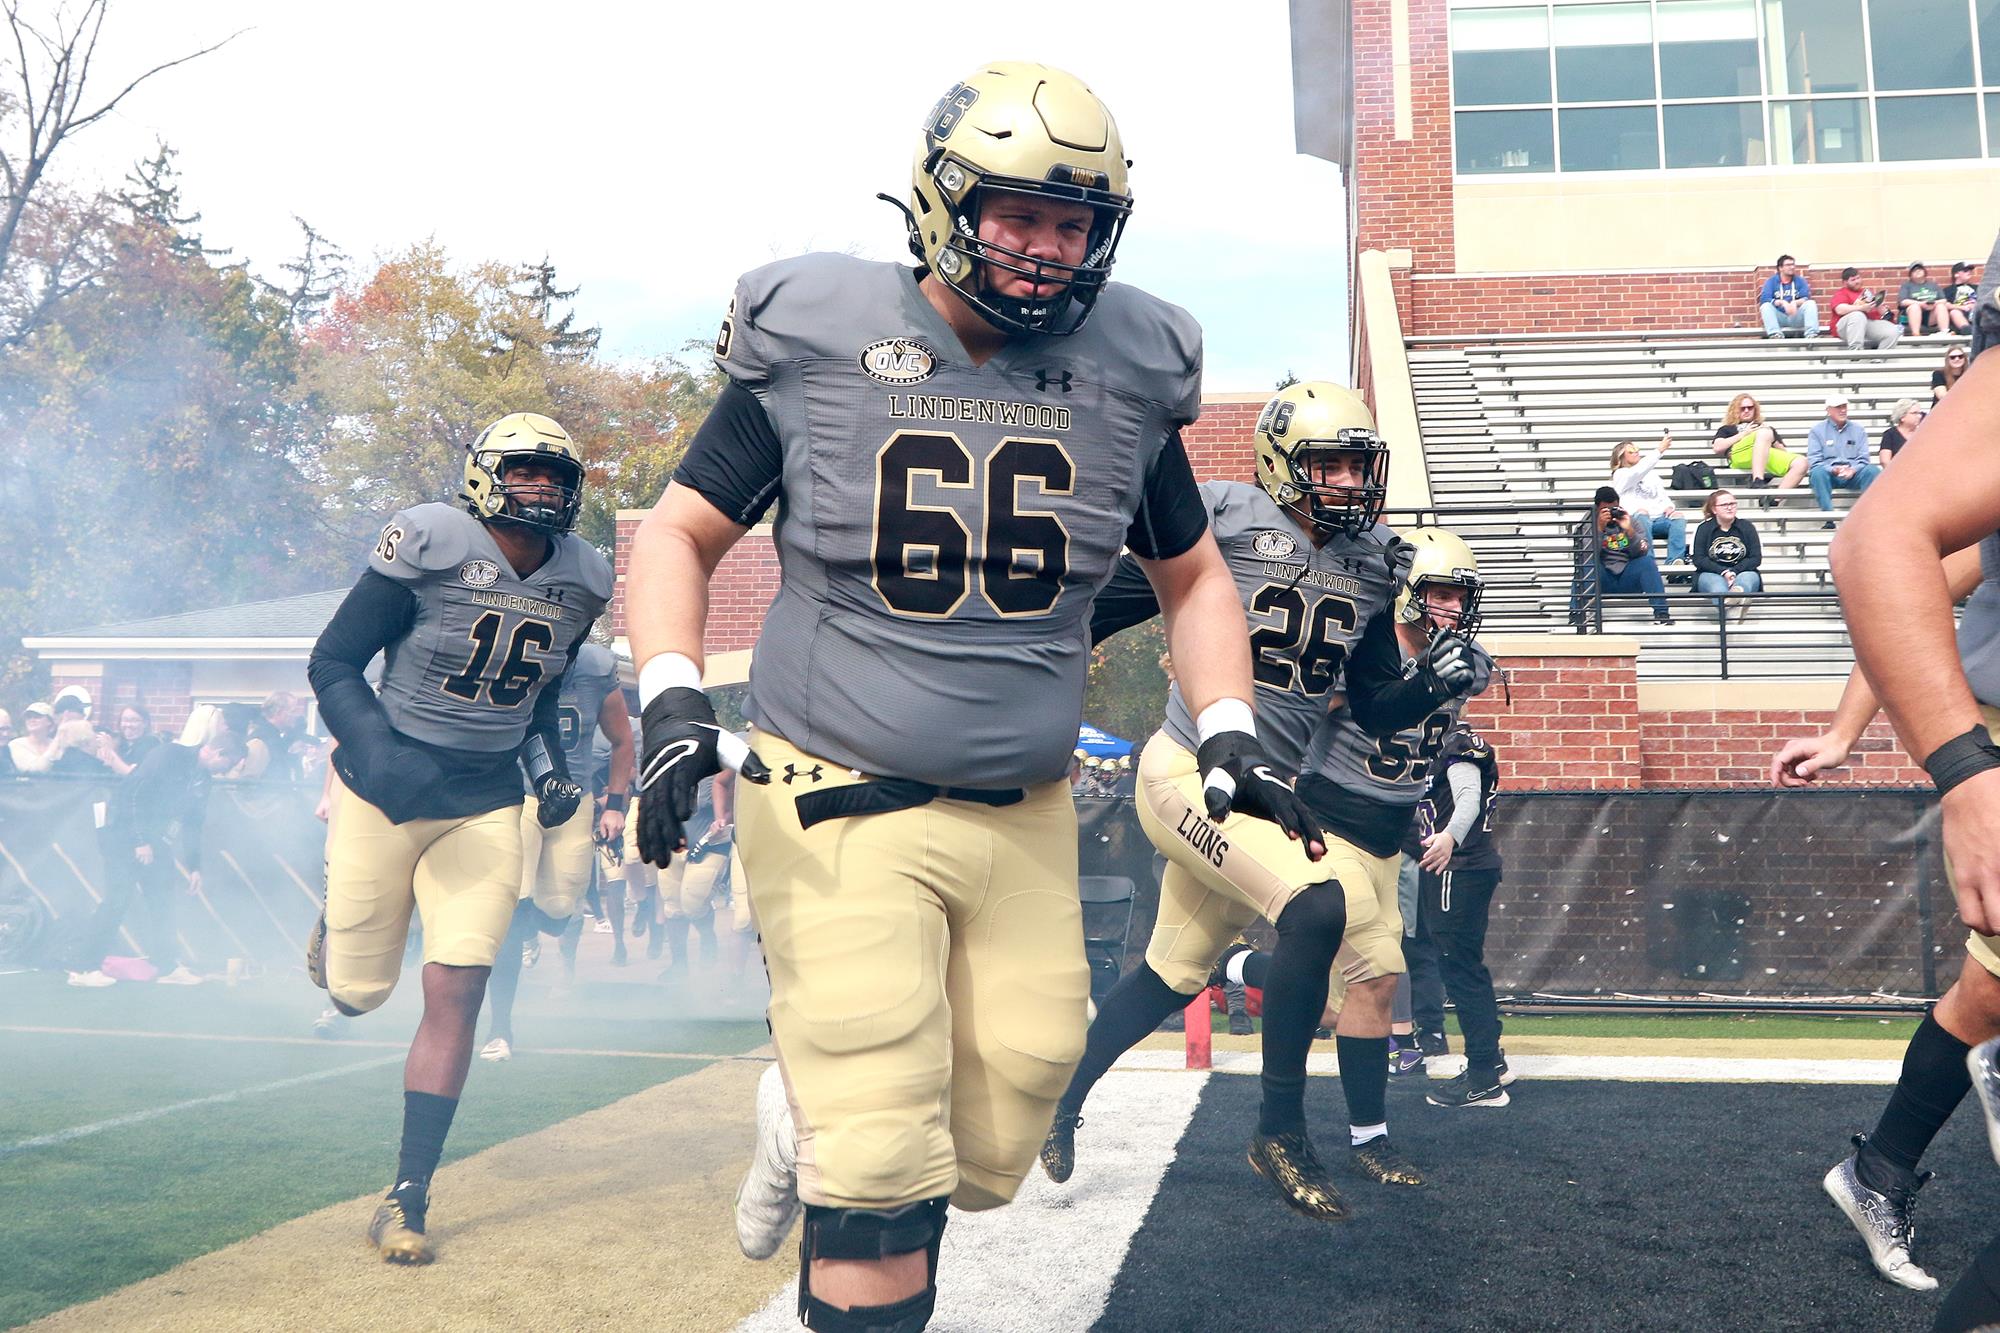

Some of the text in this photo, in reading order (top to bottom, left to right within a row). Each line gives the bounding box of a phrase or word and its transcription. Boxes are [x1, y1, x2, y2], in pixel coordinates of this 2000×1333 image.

[875, 352, 921, 372] OVC
[889, 395, 1071, 431] LINDENWOOD
[374, 521, 405, 564] 16
[871, 428, 1076, 619] 66
[1261, 540, 1287, 552] OVC
[471, 591, 562, 620] LINDENWOOD
[440, 609, 555, 708] 16
[1249, 582, 1358, 697] 26
[1176, 807, 1229, 869] LIONS
